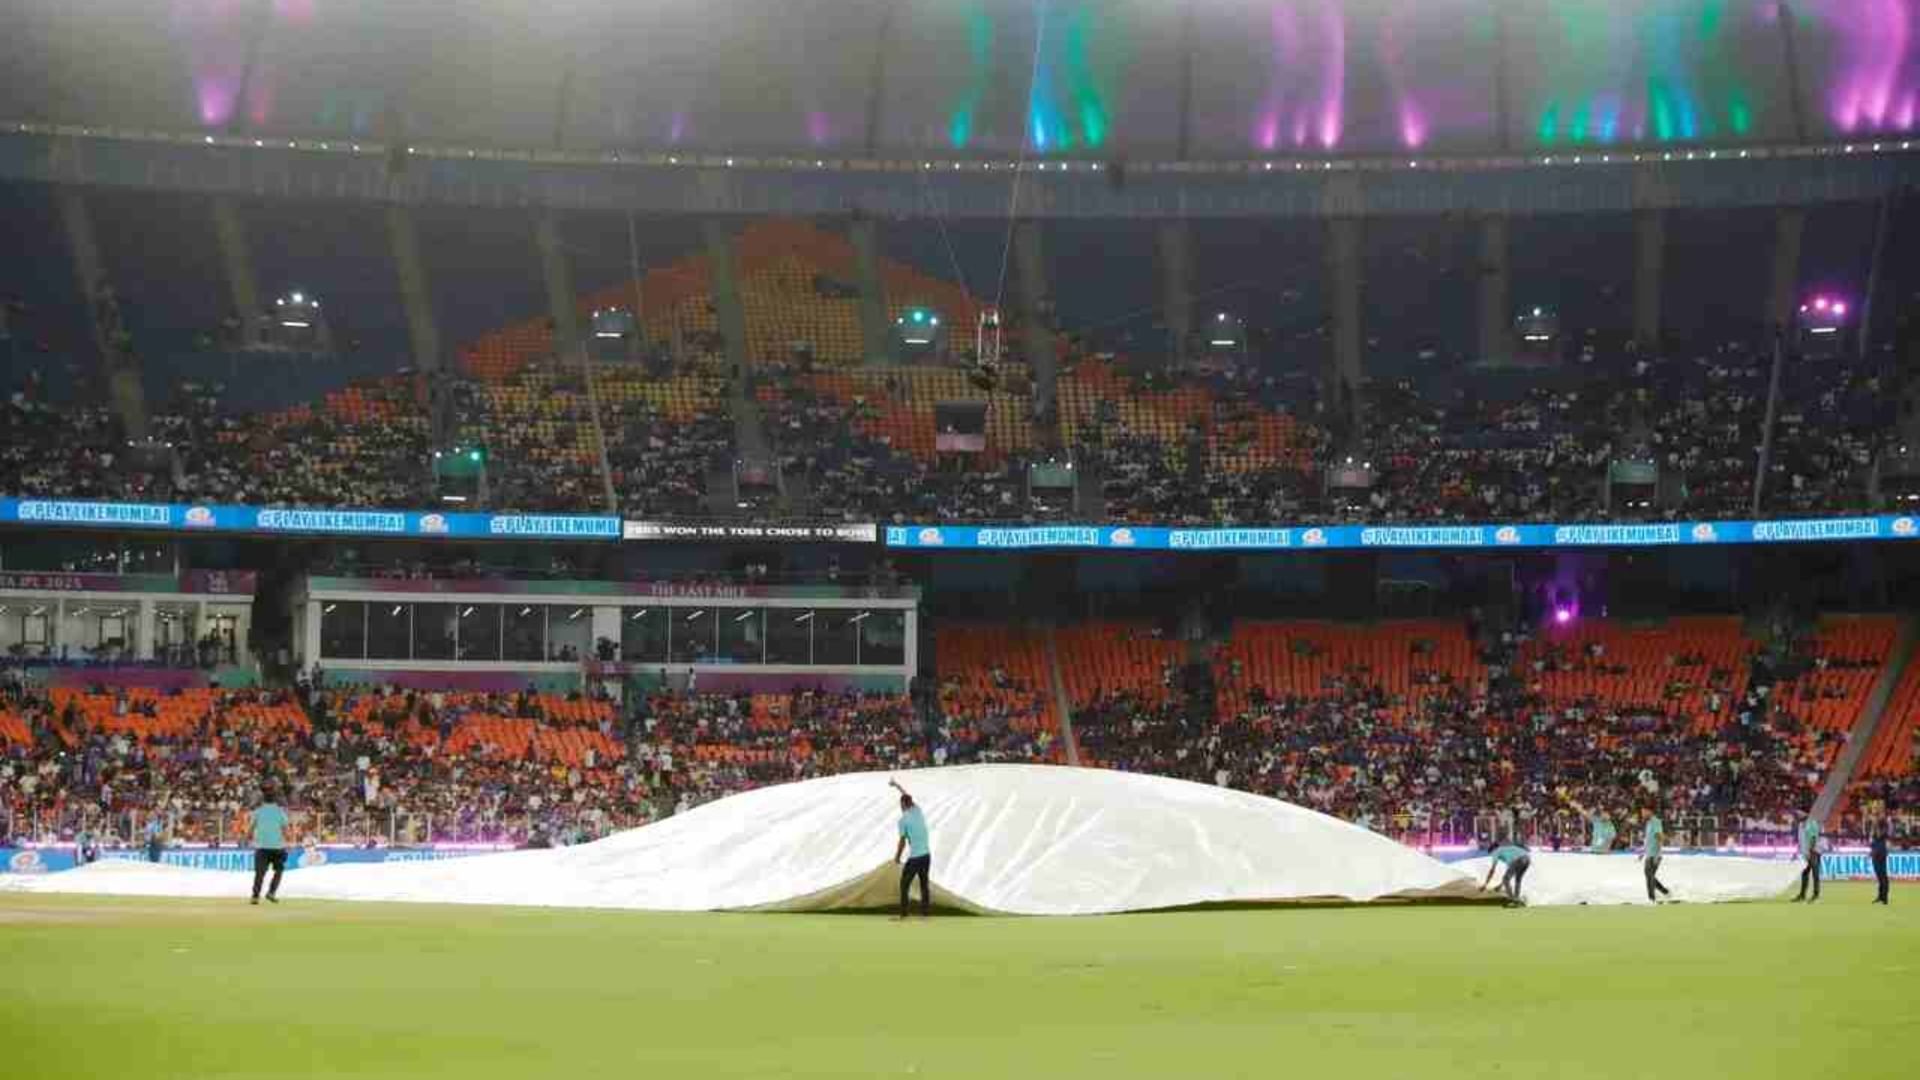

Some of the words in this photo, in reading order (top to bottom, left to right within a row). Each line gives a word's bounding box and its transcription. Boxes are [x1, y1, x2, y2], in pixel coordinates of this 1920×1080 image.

[663, 526, 696, 536] WON
[701, 526, 725, 536] THE
[730, 527, 763, 537] TOSS
[766, 527, 810, 537] CHOSE
[815, 527, 834, 537] TO
